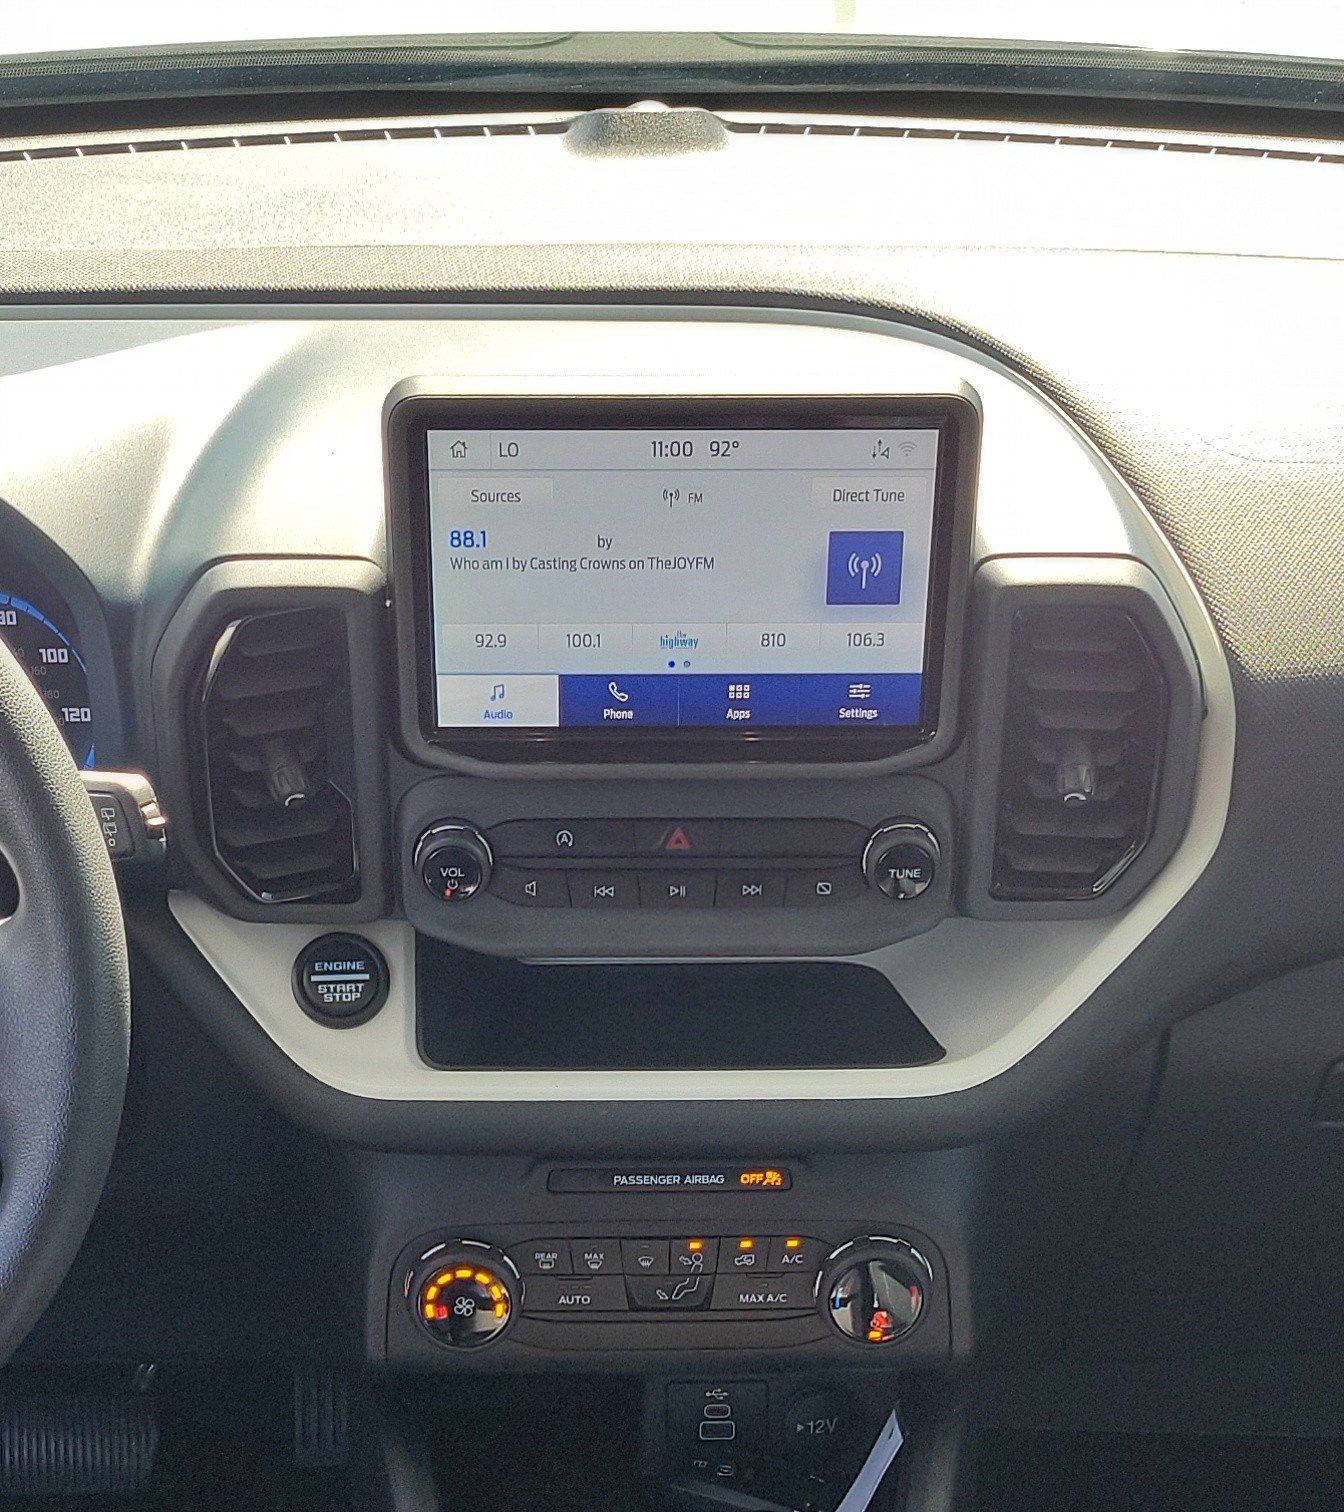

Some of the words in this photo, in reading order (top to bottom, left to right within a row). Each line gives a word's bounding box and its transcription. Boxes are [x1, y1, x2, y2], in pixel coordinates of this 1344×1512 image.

[499, 442, 519, 458] LO
[650, 441, 693, 458] 11:00
[709, 440, 740, 458] 92°
[470, 488, 522, 504] Sources
[688, 492, 704, 503] FM
[833, 488, 868, 503] Direct
[872, 488, 905, 503] Tune
[450, 530, 487, 549] 88.1
[597, 534, 613, 550] by
[450, 557, 477, 570] Who
[480, 559, 504, 570] am
[511, 557, 528, 573] by
[530, 557, 578, 573] Casting
[579, 557, 626, 571] Crowns
[628, 560, 645, 571] on
[647, 557, 715, 571] TheJOYFM
[475, 634, 508, 649] 92.9
[566, 634, 602, 649] 100.1
[659, 634, 699, 650] highway
[761, 633, 786, 648] 810
[846, 632, 886, 648] 106.3
[39, 648, 69, 663] 100
[61, 708, 91, 723] 120
[483, 708, 513, 720] Audio
[603, 707, 634, 720] Phone
[726, 708, 751, 722] Apps
[839, 707, 878, 722] Settings
[440, 867, 465, 879] VOL
[888, 868, 922, 879] TUNE
[314, 960, 365, 972] ENGINE
[318, 983, 365, 994] START
[324, 992, 361, 1003] STOP
[613, 1174, 681, 1186] PASSENGER
[684, 1174, 725, 1185] AIRBAG
[740, 1172, 764, 1185] OFF
[584, 1253, 605, 1261] MAX
[782, 1254, 804, 1264] A/C
[558, 1295, 591, 1305] AUTO
[739, 1294, 764, 1304] MAX
[765, 1293, 787, 1304] A/C
[806, 1418, 838, 1434] 12V
